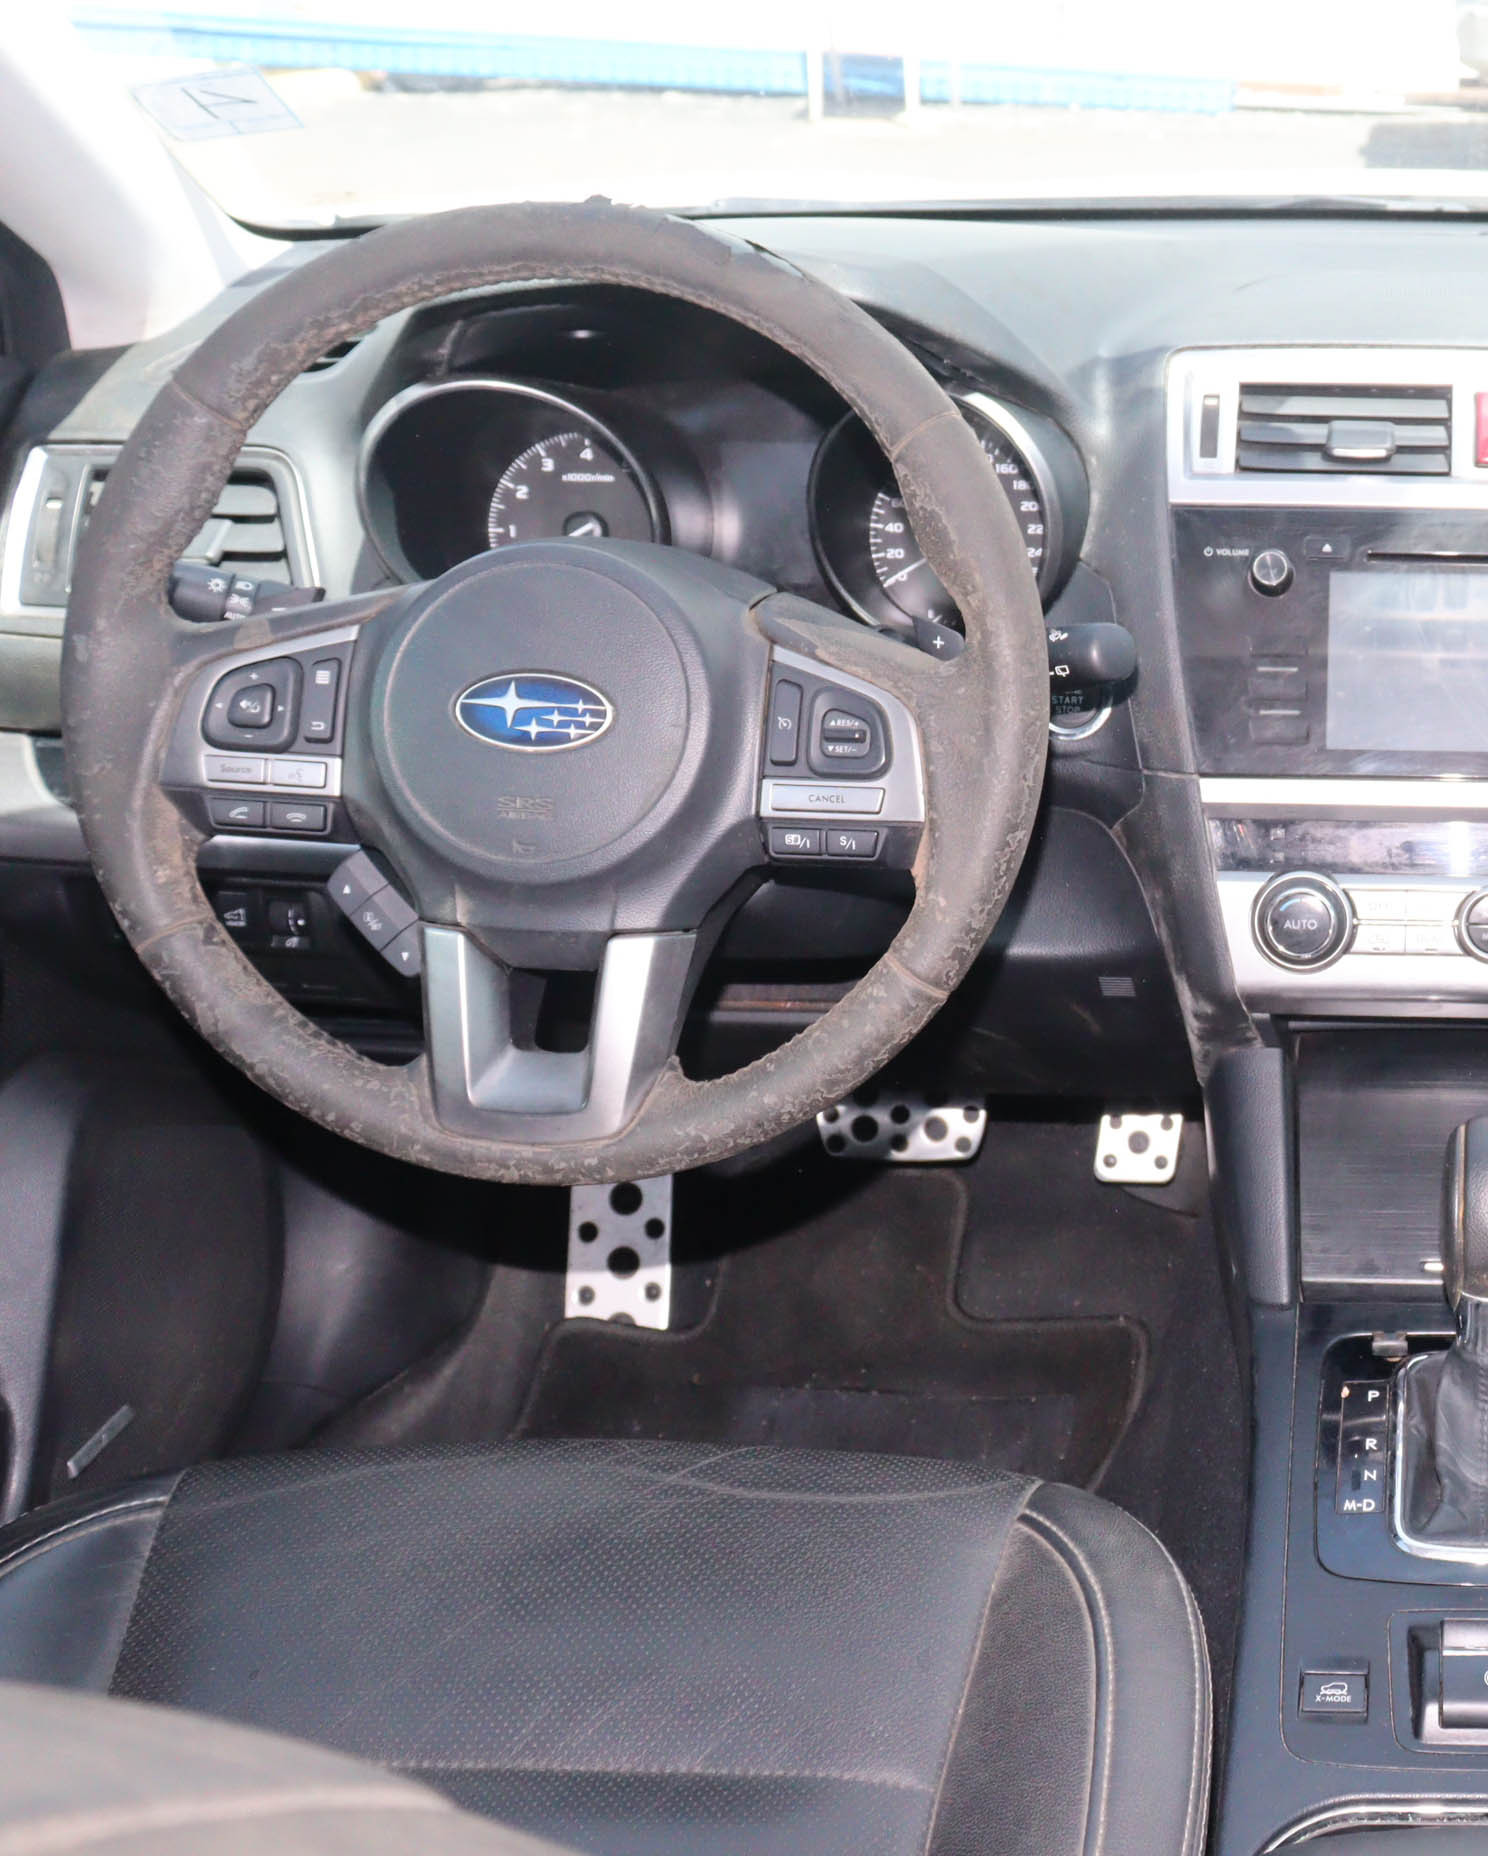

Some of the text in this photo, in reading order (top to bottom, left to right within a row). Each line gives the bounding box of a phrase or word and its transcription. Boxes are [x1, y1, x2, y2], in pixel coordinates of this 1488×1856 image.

[580, 448, 593, 461] 4
[541, 458, 555, 472] 3
[1013, 479, 1030, 490] 18
[515, 485, 529, 499] 2
[508, 524, 516, 538] 1
[885, 522, 904, 534] 40
[886, 548, 905, 559] 20
[1215, 548, 1250, 556] VOLUME
[1052, 695, 1084, 705] START
[497, 796, 554, 810] SRS
[808, 794, 844, 804] CANCEL
[1284, 919, 1318, 930] AUTO
[1367, 1390, 1380, 1402] P
[1365, 1438, 1378, 1450] R
[1364, 1470, 1377, 1481] N
[1344, 1499, 1375, 1511] M-D
[1315, 1694, 1352, 1703] X-MODE
